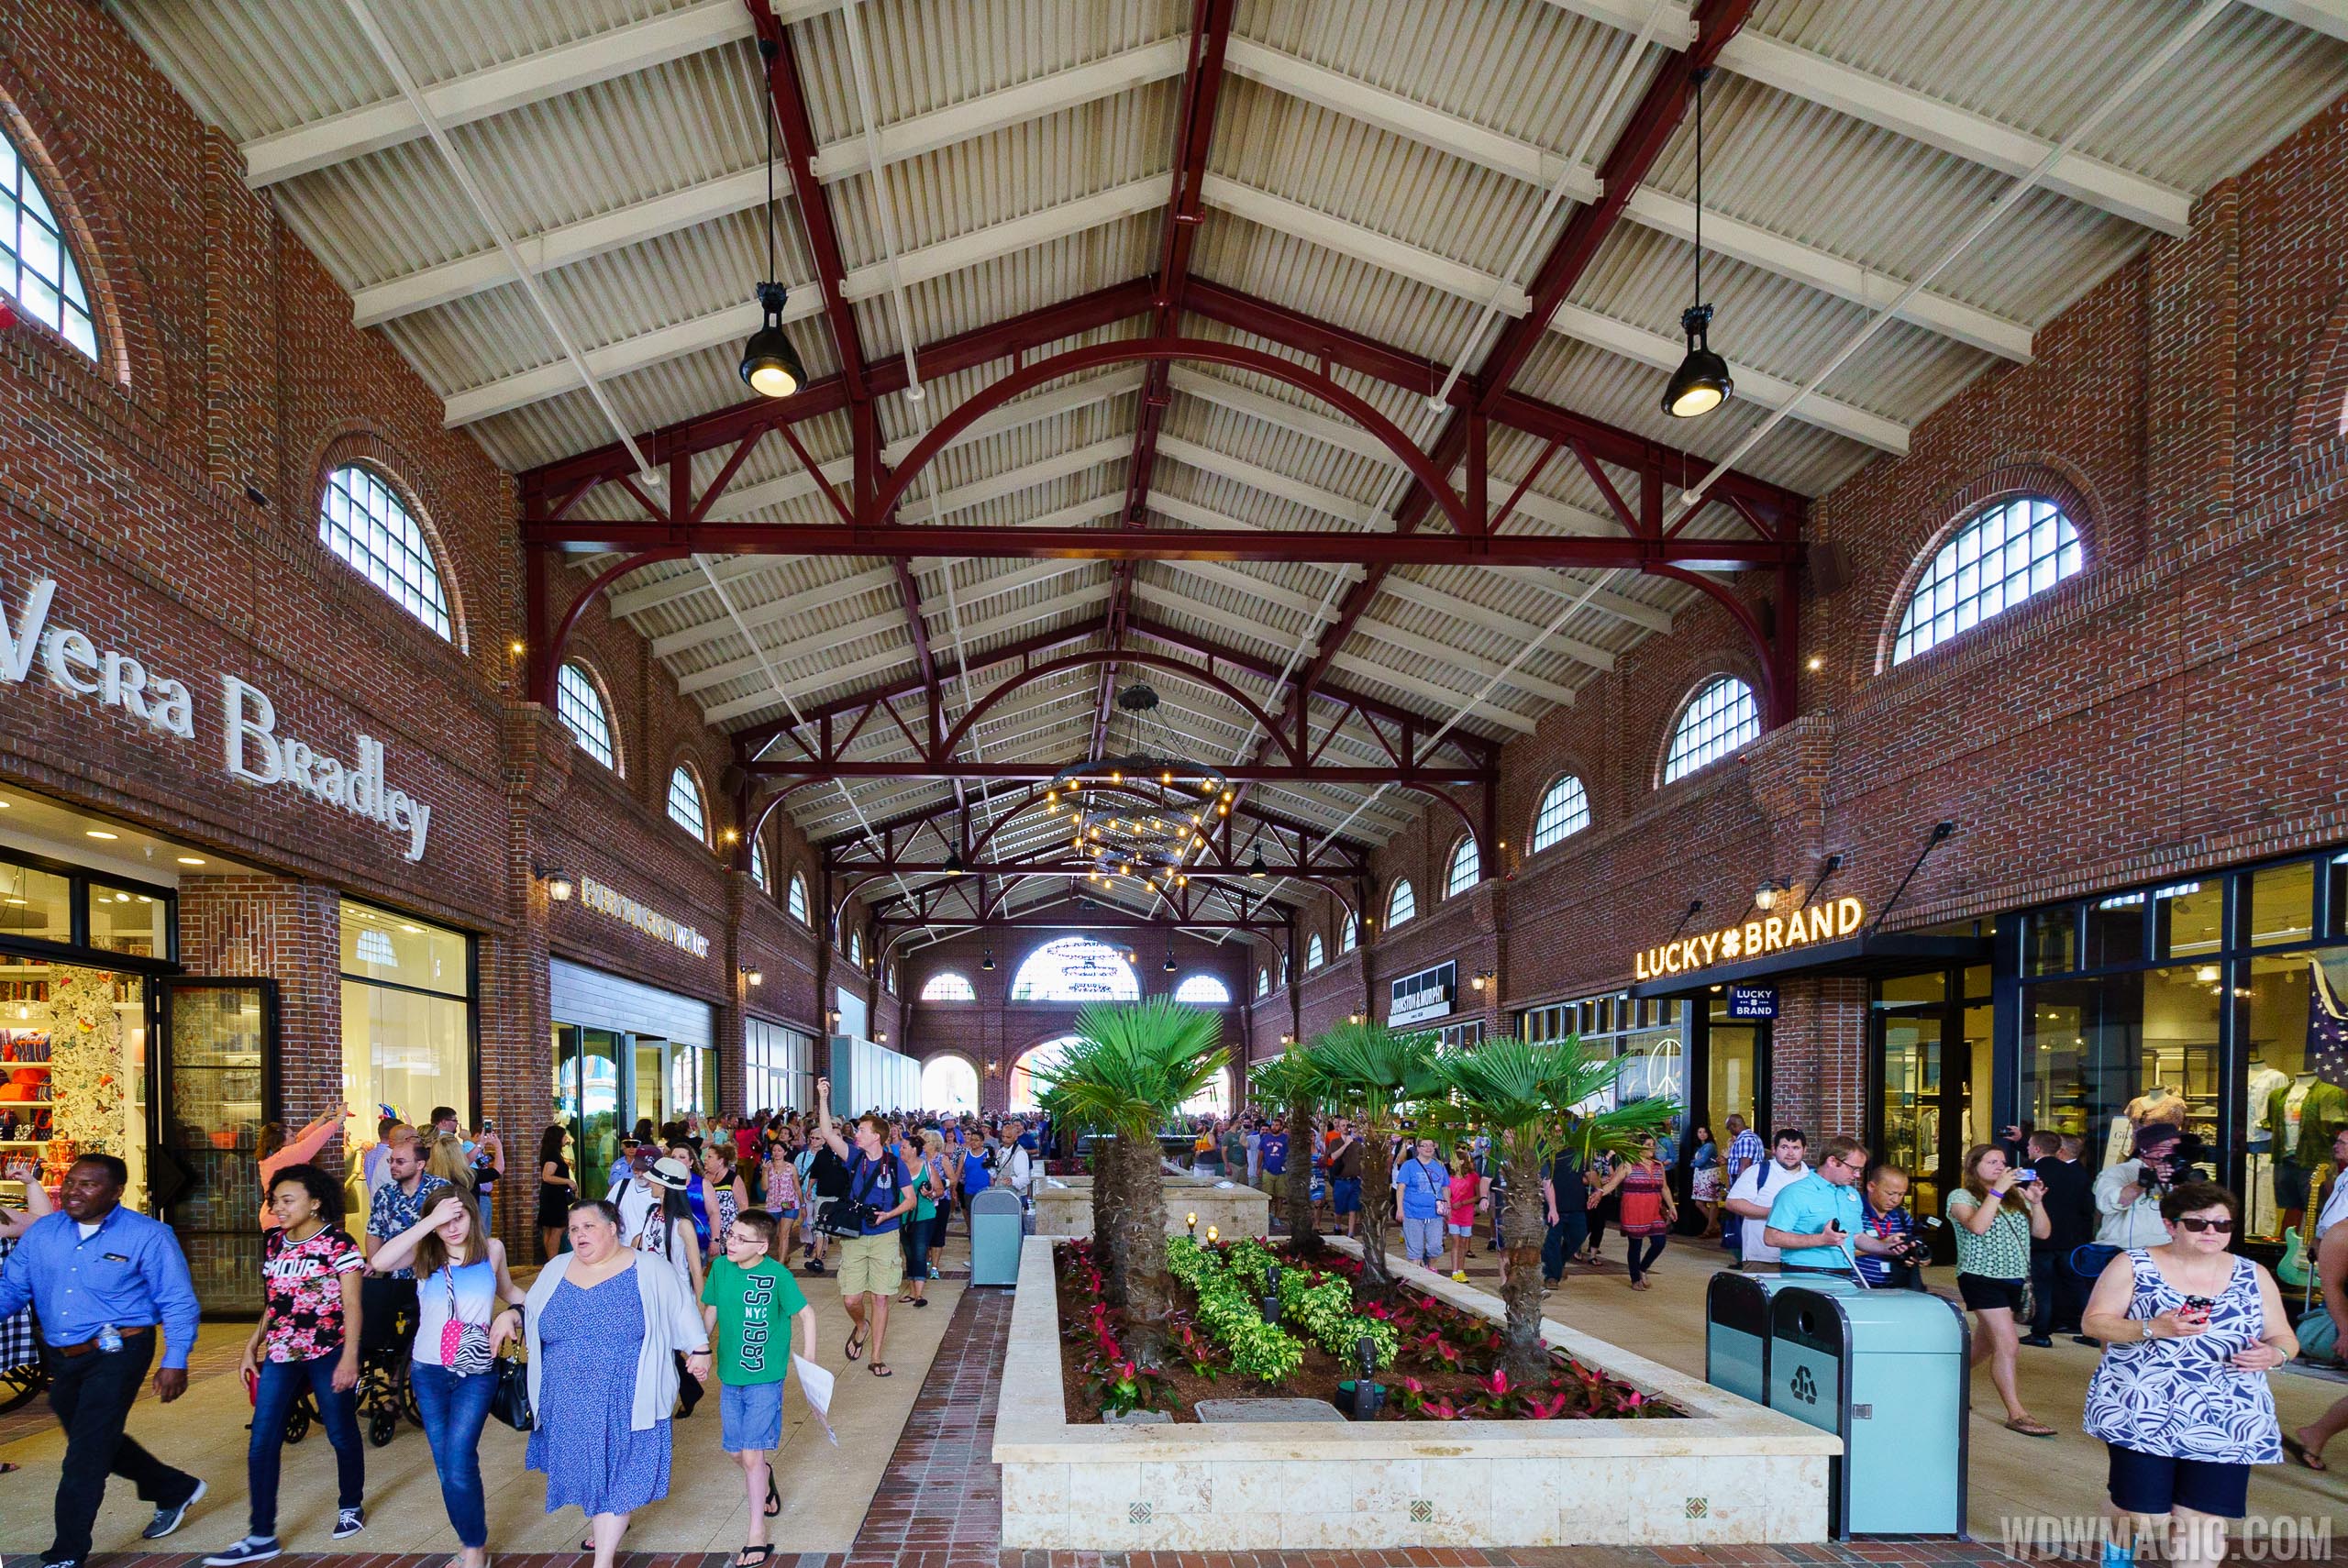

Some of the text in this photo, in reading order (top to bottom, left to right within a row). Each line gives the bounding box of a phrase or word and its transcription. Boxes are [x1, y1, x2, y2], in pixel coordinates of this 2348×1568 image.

[224, 675, 430, 862] Bradley
[1636, 897, 1863, 980] LUCKY BRAND
[1421, 984, 1445, 1008] MURPHY
[1736, 989, 1772, 999] LUCKY
[1736, 1007, 1772, 1015] BRAND
[743, 1274, 776, 1306] PS
[745, 1307, 768, 1320] NYC
[739, 1320, 769, 1372] 1987
